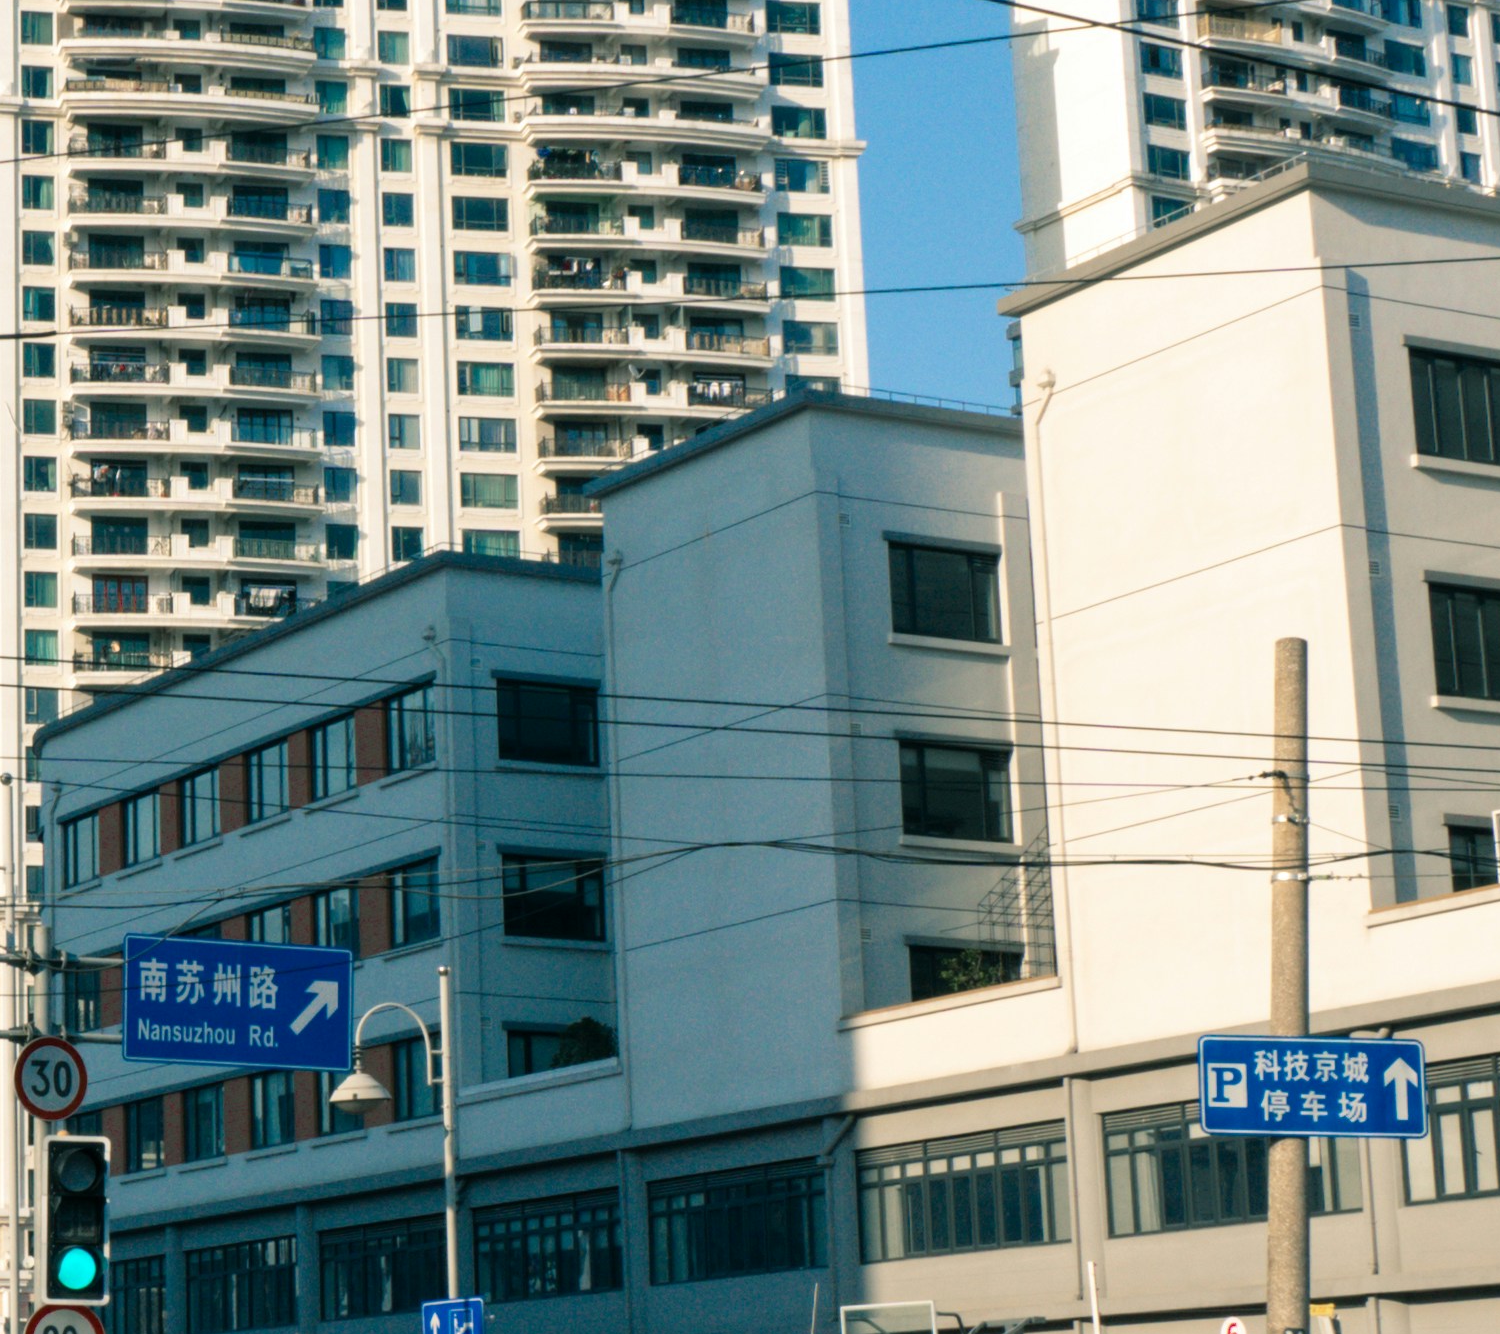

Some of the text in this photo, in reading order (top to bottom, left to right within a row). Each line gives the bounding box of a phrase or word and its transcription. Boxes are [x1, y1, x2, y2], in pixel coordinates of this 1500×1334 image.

[139, 958, 278, 1010] 南苏州路
[138, 1018, 278, 1047] Nansuzhou Rd.
[31, 1060, 72, 1098] 30
[1254, 1050, 1369, 1084] 科技京城
[1211, 1067, 1243, 1103] P
[1260, 1089, 1367, 1123] 停车场
